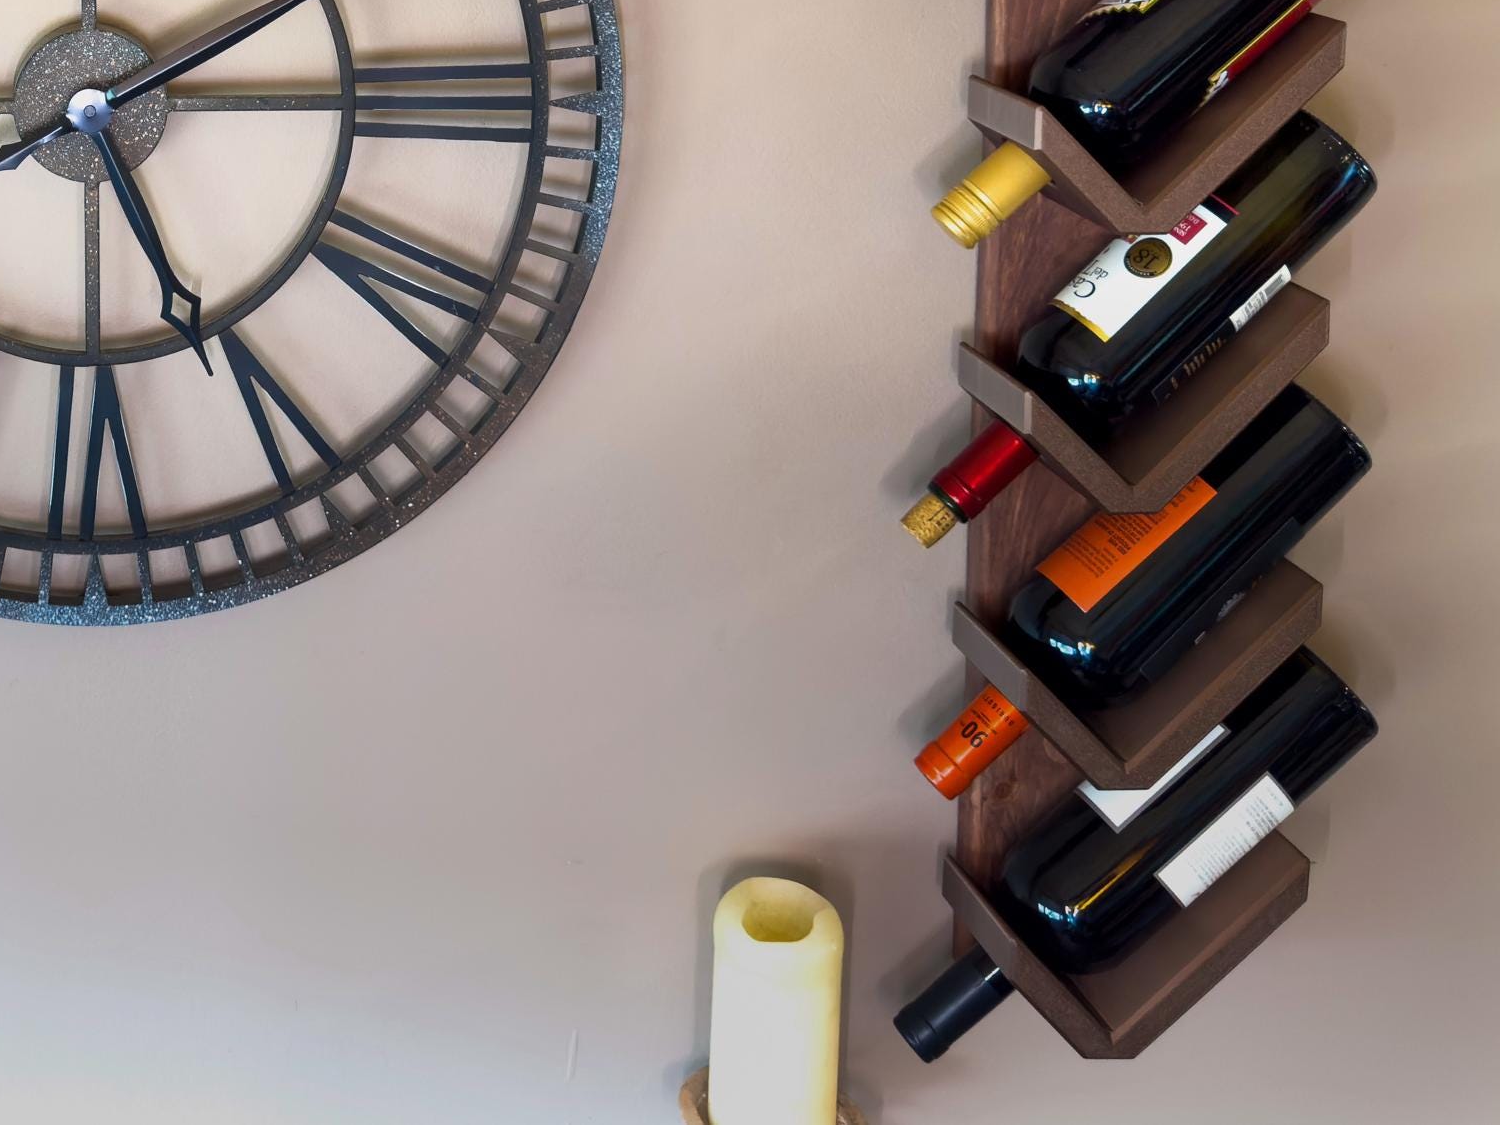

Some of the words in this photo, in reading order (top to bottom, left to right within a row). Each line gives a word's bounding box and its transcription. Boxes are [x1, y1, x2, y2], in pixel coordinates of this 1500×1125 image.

[354, 63, 532, 141] III
[47, 364, 148, 540] VI
[219, 330, 342, 495] V
[961, 721, 988, 747] 90
